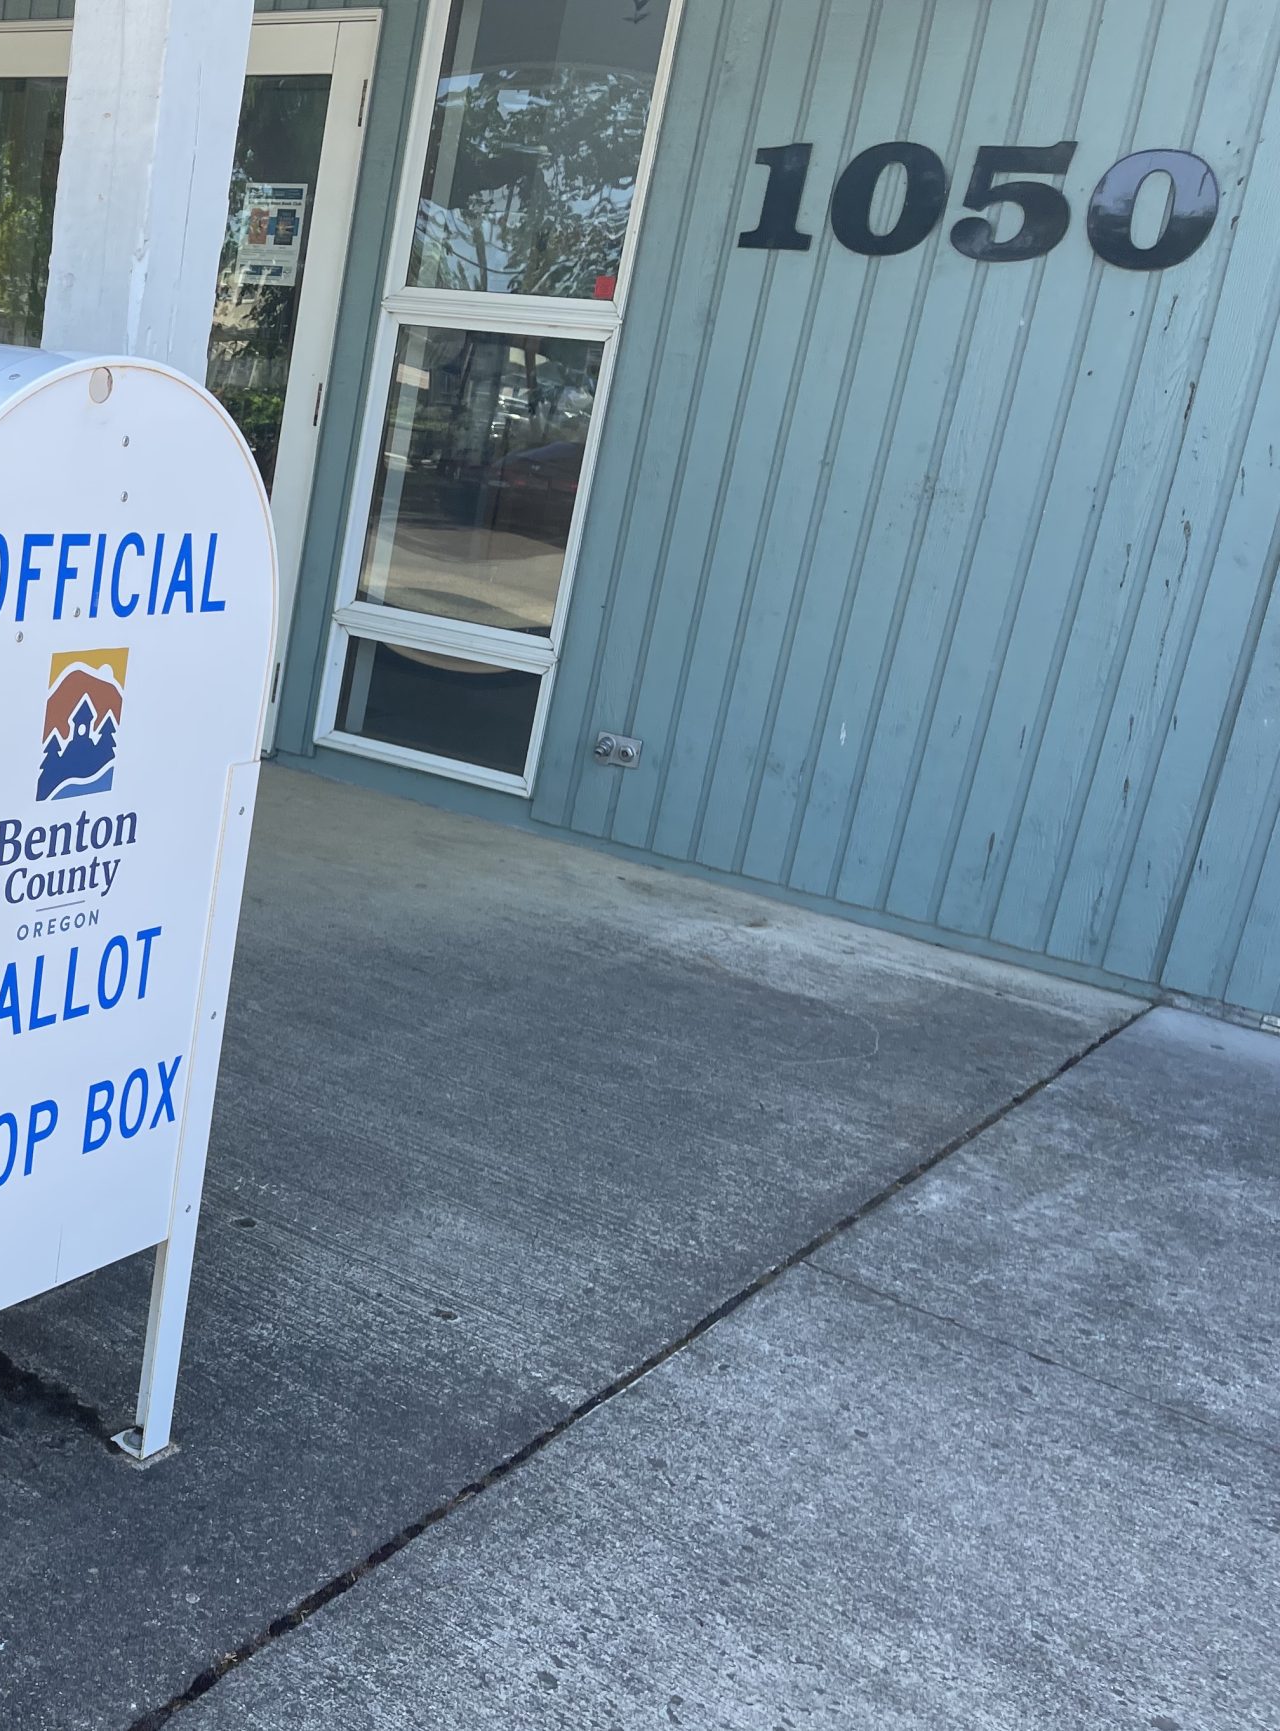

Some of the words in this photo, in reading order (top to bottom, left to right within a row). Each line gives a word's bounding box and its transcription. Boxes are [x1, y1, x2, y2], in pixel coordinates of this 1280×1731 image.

[738, 140, 1221, 271] 1050
[4, 856, 122, 904] County
[16, 908, 100, 941] OREGON
[82, 1054, 183, 1155] BOX
